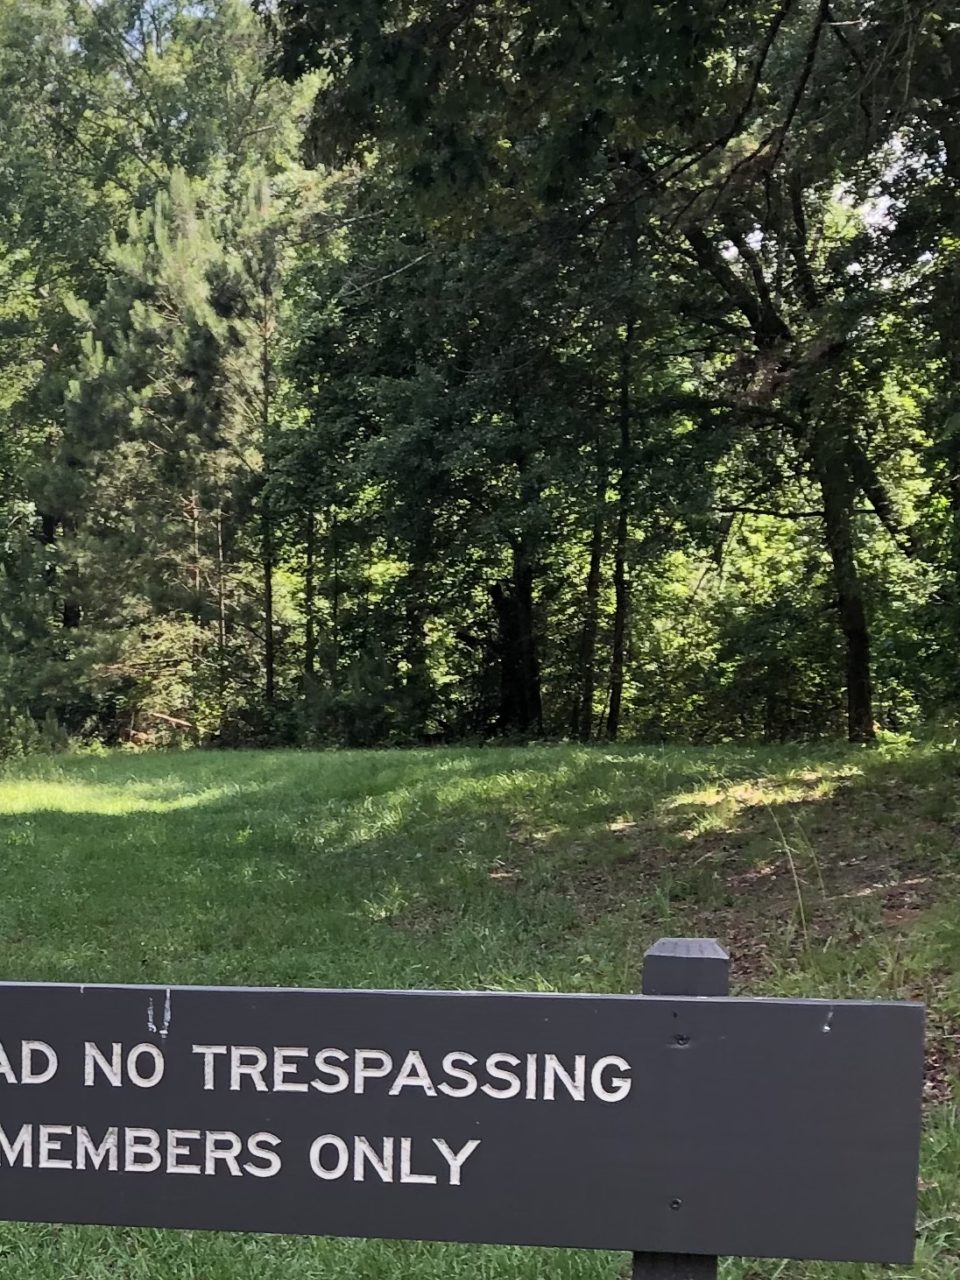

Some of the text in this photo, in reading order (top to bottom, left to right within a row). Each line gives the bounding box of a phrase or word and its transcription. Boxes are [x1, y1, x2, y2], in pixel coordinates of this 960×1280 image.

[83, 1040, 166, 1090] NO
[190, 1043, 633, 1104] TRESPASSING
[308, 1132, 482, 1187] ONLY
